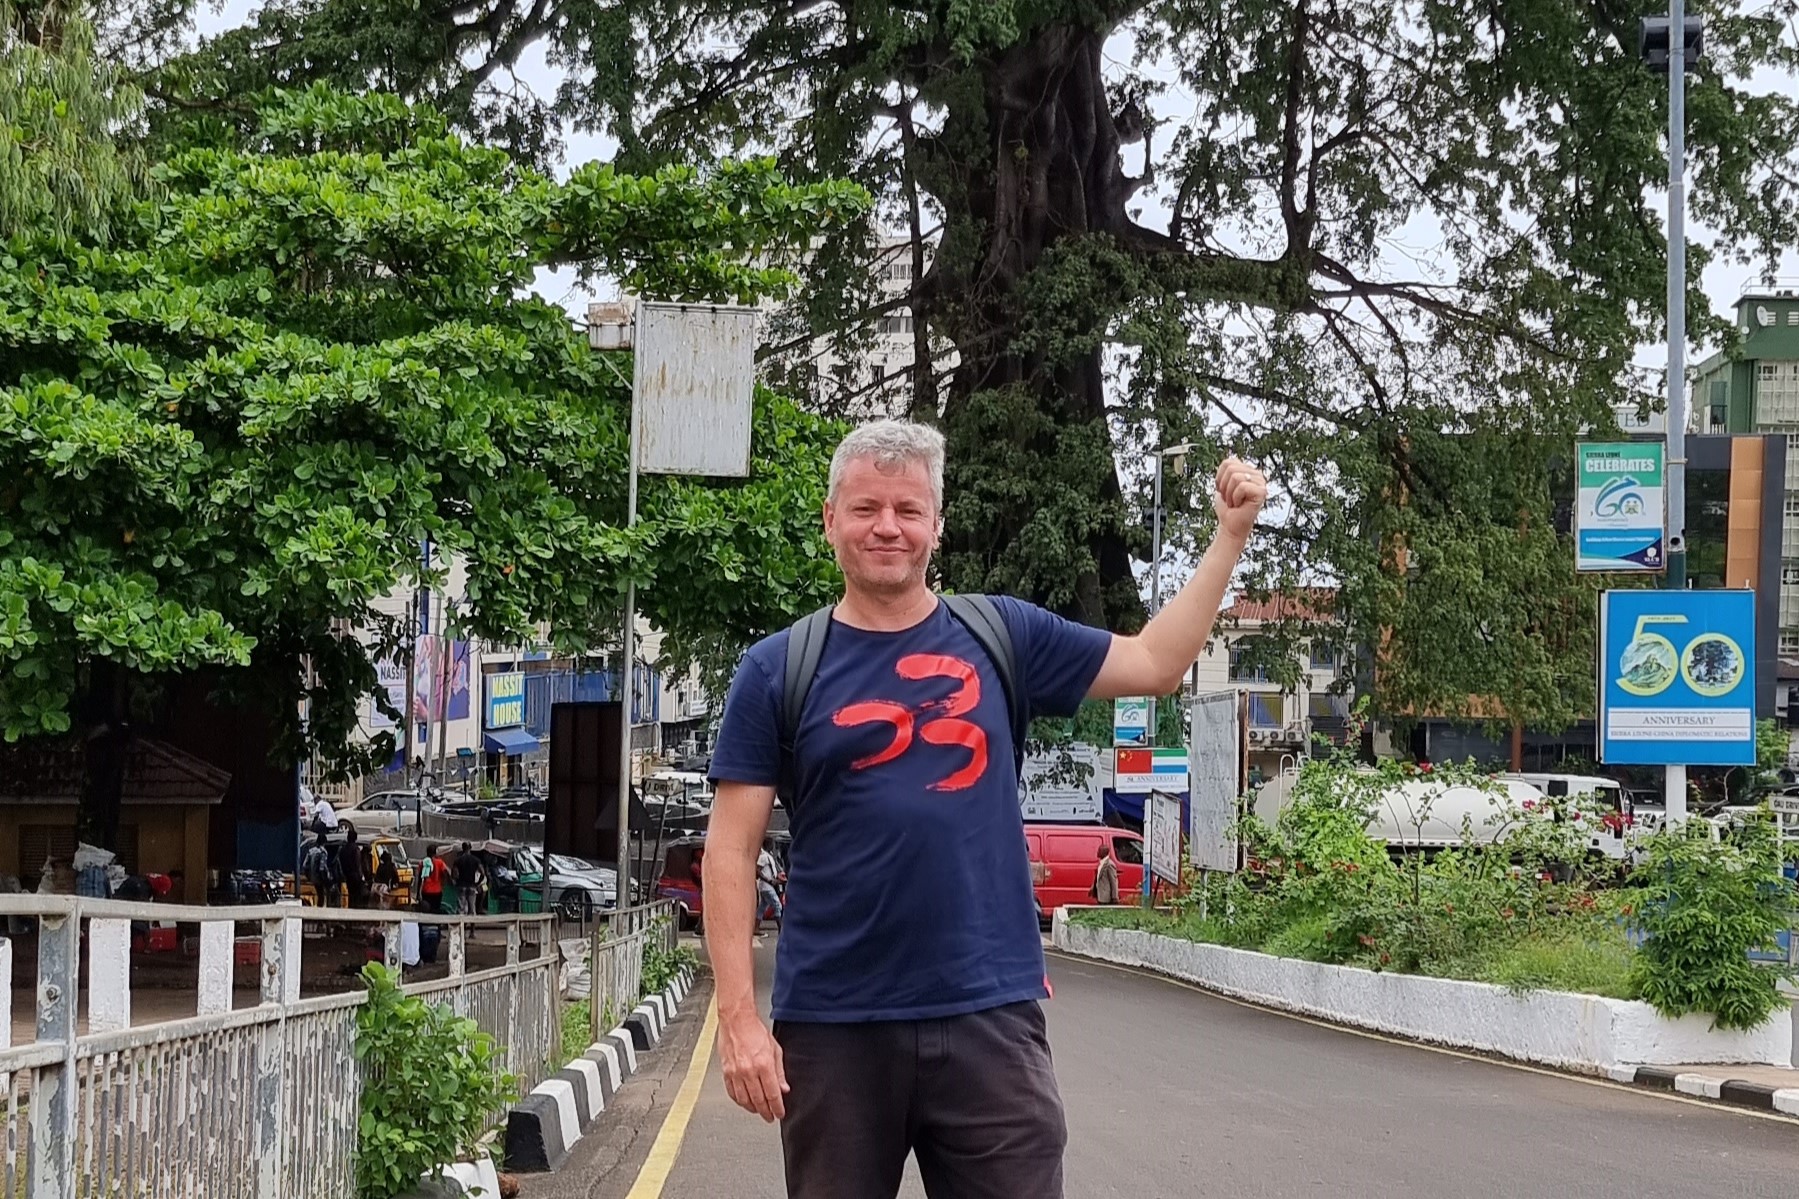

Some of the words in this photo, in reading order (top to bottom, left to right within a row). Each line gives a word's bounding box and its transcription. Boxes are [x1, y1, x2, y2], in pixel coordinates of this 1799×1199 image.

[1585, 459, 1655, 472] CELEBRATES
[1615, 614, 1745, 697] 50
[492, 674, 523, 698] NASSIT
[493, 701, 522, 726] HOUSE
[1642, 716, 1715, 725] ANNIVERSARY
